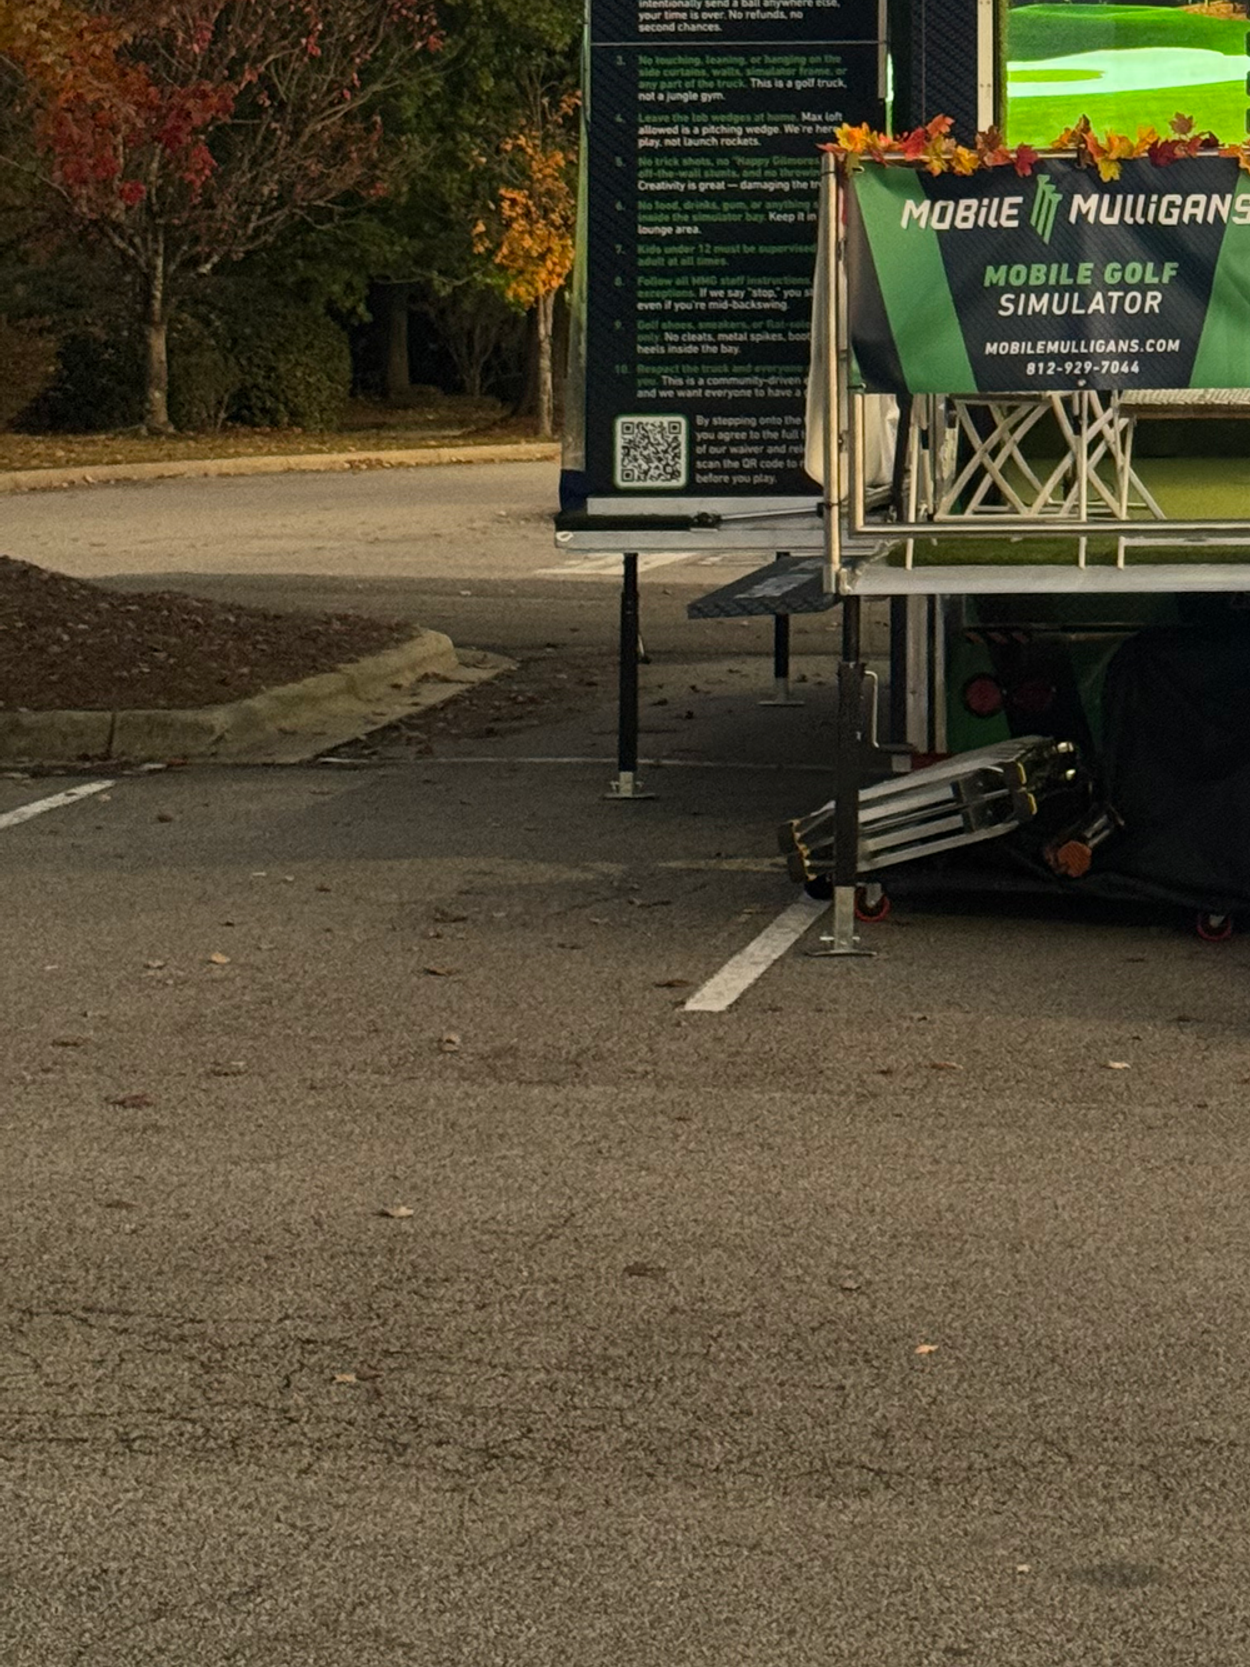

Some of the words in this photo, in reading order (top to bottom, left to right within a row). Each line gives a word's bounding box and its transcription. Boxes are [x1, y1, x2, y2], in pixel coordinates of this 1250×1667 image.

[638, 0, 702, 10] intentionally
[732, 0, 739, 8] a
[638, 12, 662, 22] your
[663, 10, 688, 20] time
[689, 9, 700, 19] is
[700, 11, 726, 19] over.
[728, 9, 744, 19] No
[744, 9, 788, 20] refunds,
[789, 11, 804, 19] no
[638, 22, 676, 32] second
[677, 21, 722, 32] chances.
[750, 78, 773, 88] This
[774, 78, 784, 88] is
[786, 80, 793, 88] a
[794, 78, 815, 90] golf
[817, 78, 847, 88] truck,
[637, 91, 656, 101] not
[657, 93, 665, 101] a
[666, 91, 699, 103] jungle
[700, 93, 725, 102] gym.
[801, 113, 823, 122] Max
[824, 112, 843, 122] loft
[637, 125, 680, 135] allowed
[680, 125, 691, 135] is
[692, 127, 700, 135] a
[701, 125, 744, 137] pitching
[744, 125, 782, 136] wedge.
[783, 124, 814, 134] We're
[815, 124, 840, 134] her
[637, 137, 662, 149] play,
[663, 137, 681, 146] not
[683, 137, 719, 146] launch
[720, 137, 761, 146] rockets.
[768, 212, 796, 223] Keep
[797, 212, 805, 221] it
[806, 212, 819, 221] in
[636, 224, 674, 237] lounge
[674, 226, 703, 234] area.
[984, 262, 1092, 288] MOBILE
[1104, 262, 1179, 285] GOLF
[637, 302, 662, 310] even
[664, 300, 672, 310] if
[674, 299, 706, 312] you're
[998, 291, 1162, 316] SIMULATOR
[636, 344, 666, 354] heels
[666, 344, 700, 354] inside
[700, 344, 719, 354] the
[720, 343, 741, 356] bay.
[985, 338, 1180, 356] MOBILEMULLIGANS.COM
[1026, 360, 1140, 376] 812-929-7044
[695, 473, 730, 483] before
[731, 475, 752, 485] you
[752, 473, 777, 485] play.
